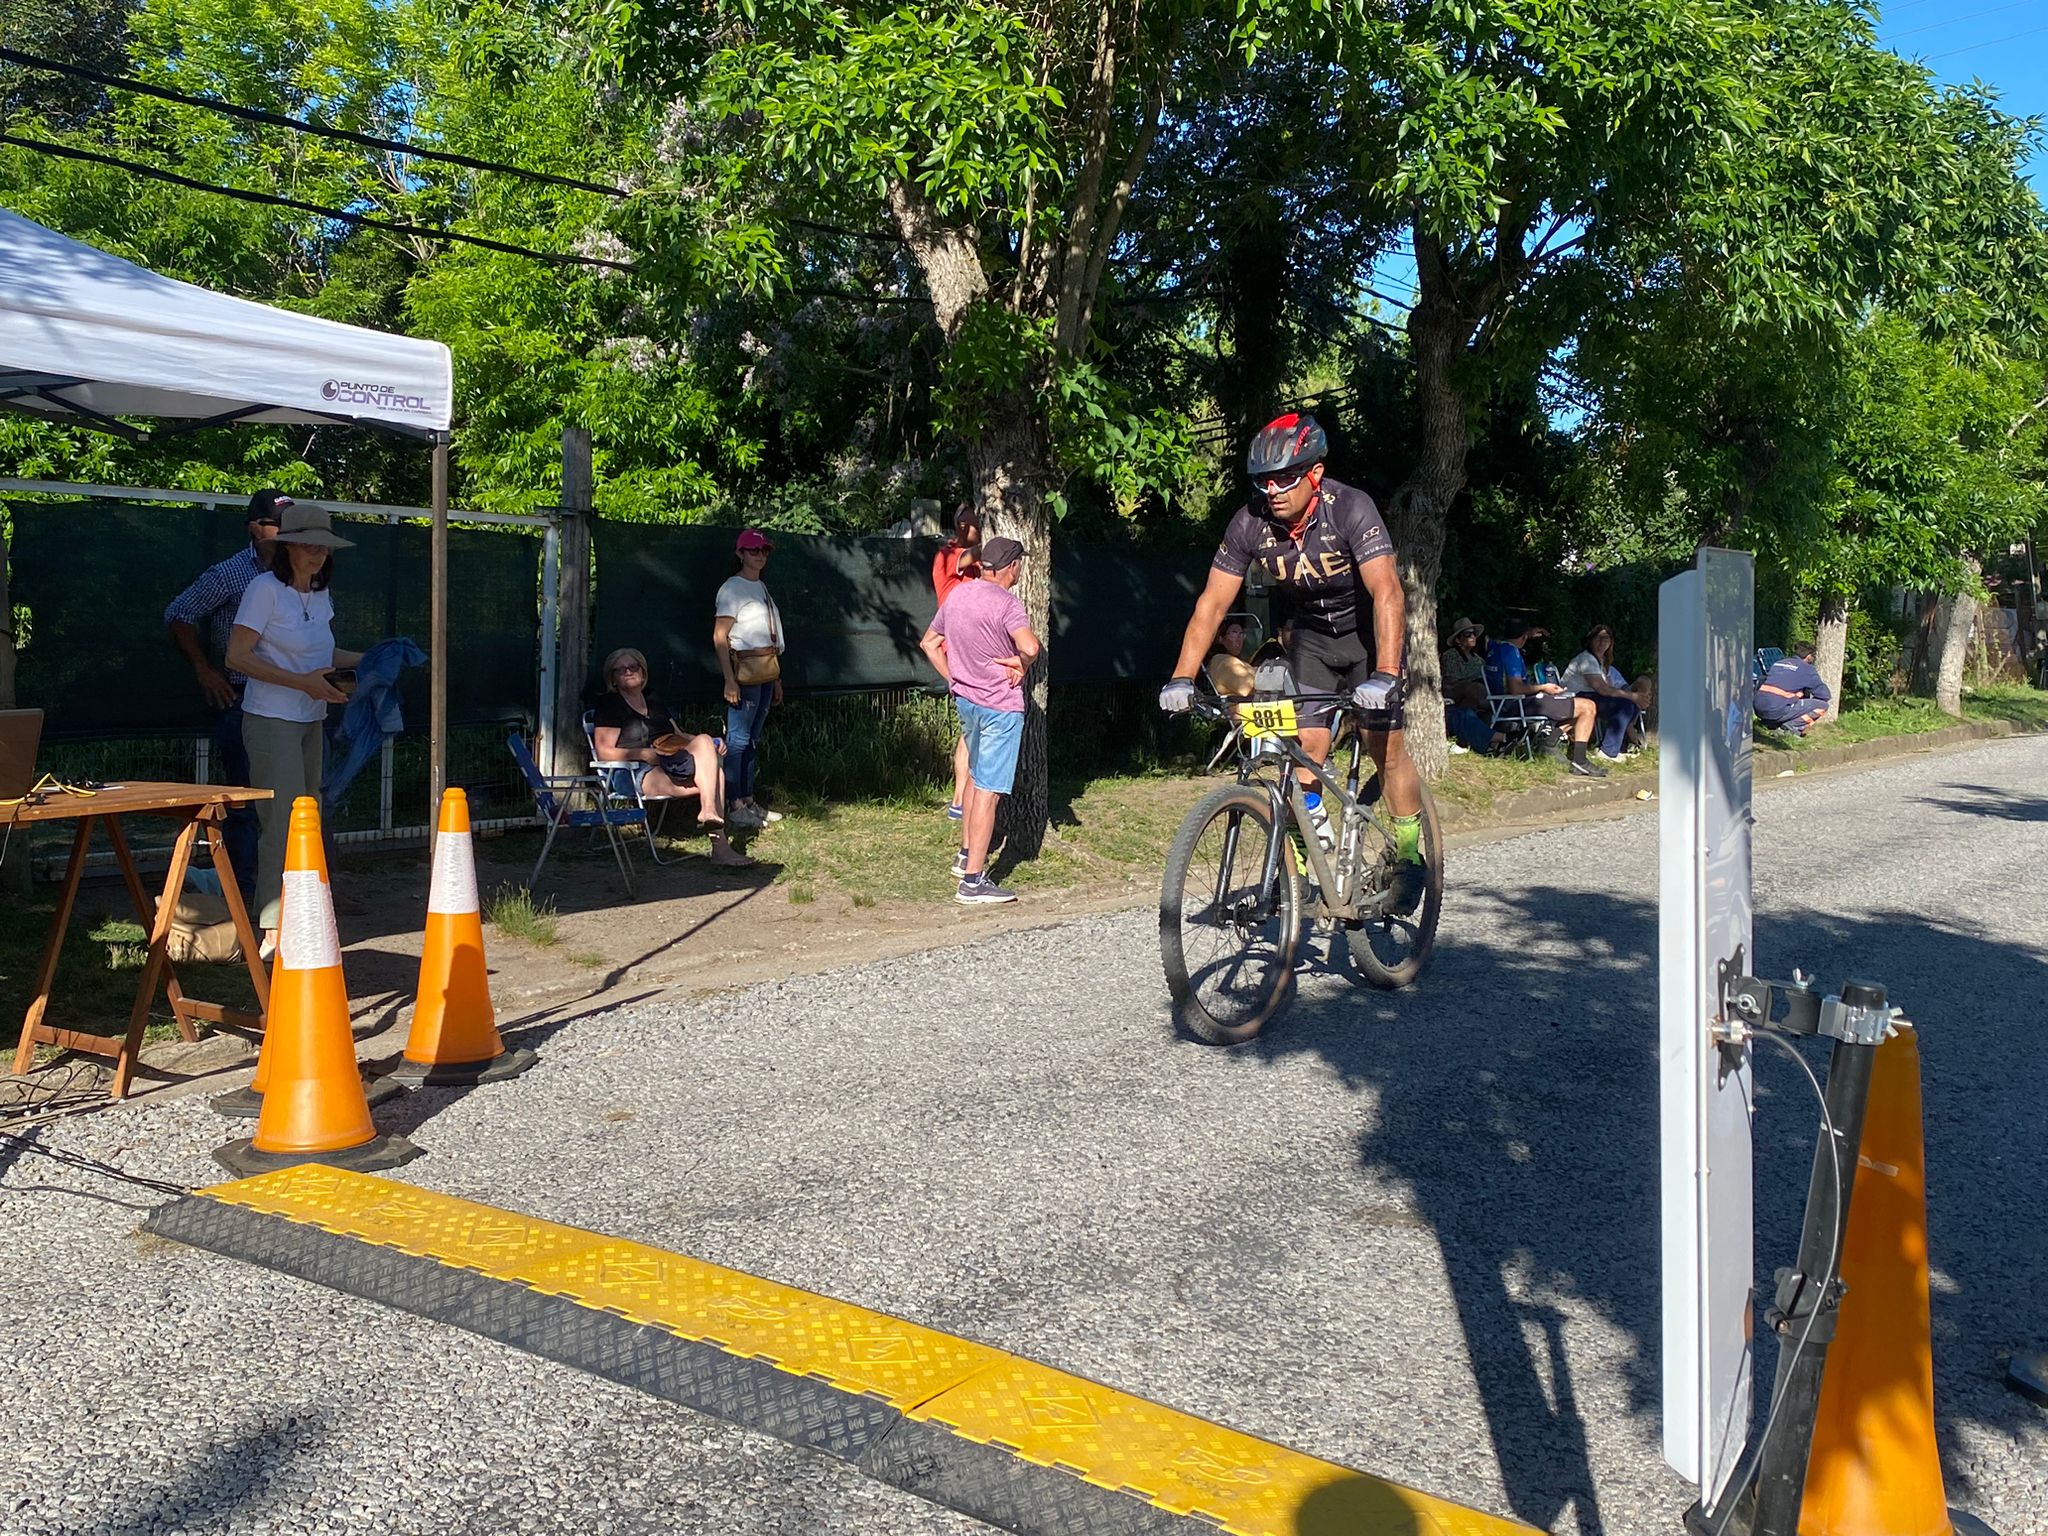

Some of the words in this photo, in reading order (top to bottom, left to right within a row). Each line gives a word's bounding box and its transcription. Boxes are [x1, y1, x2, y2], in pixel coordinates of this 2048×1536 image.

[340, 381, 379, 392] PUNTO
[380, 385, 396, 394] DE
[338, 389, 432, 410] CONTROL
[1260, 551, 1351, 581] UAE
[1253, 709, 1284, 728] 881
